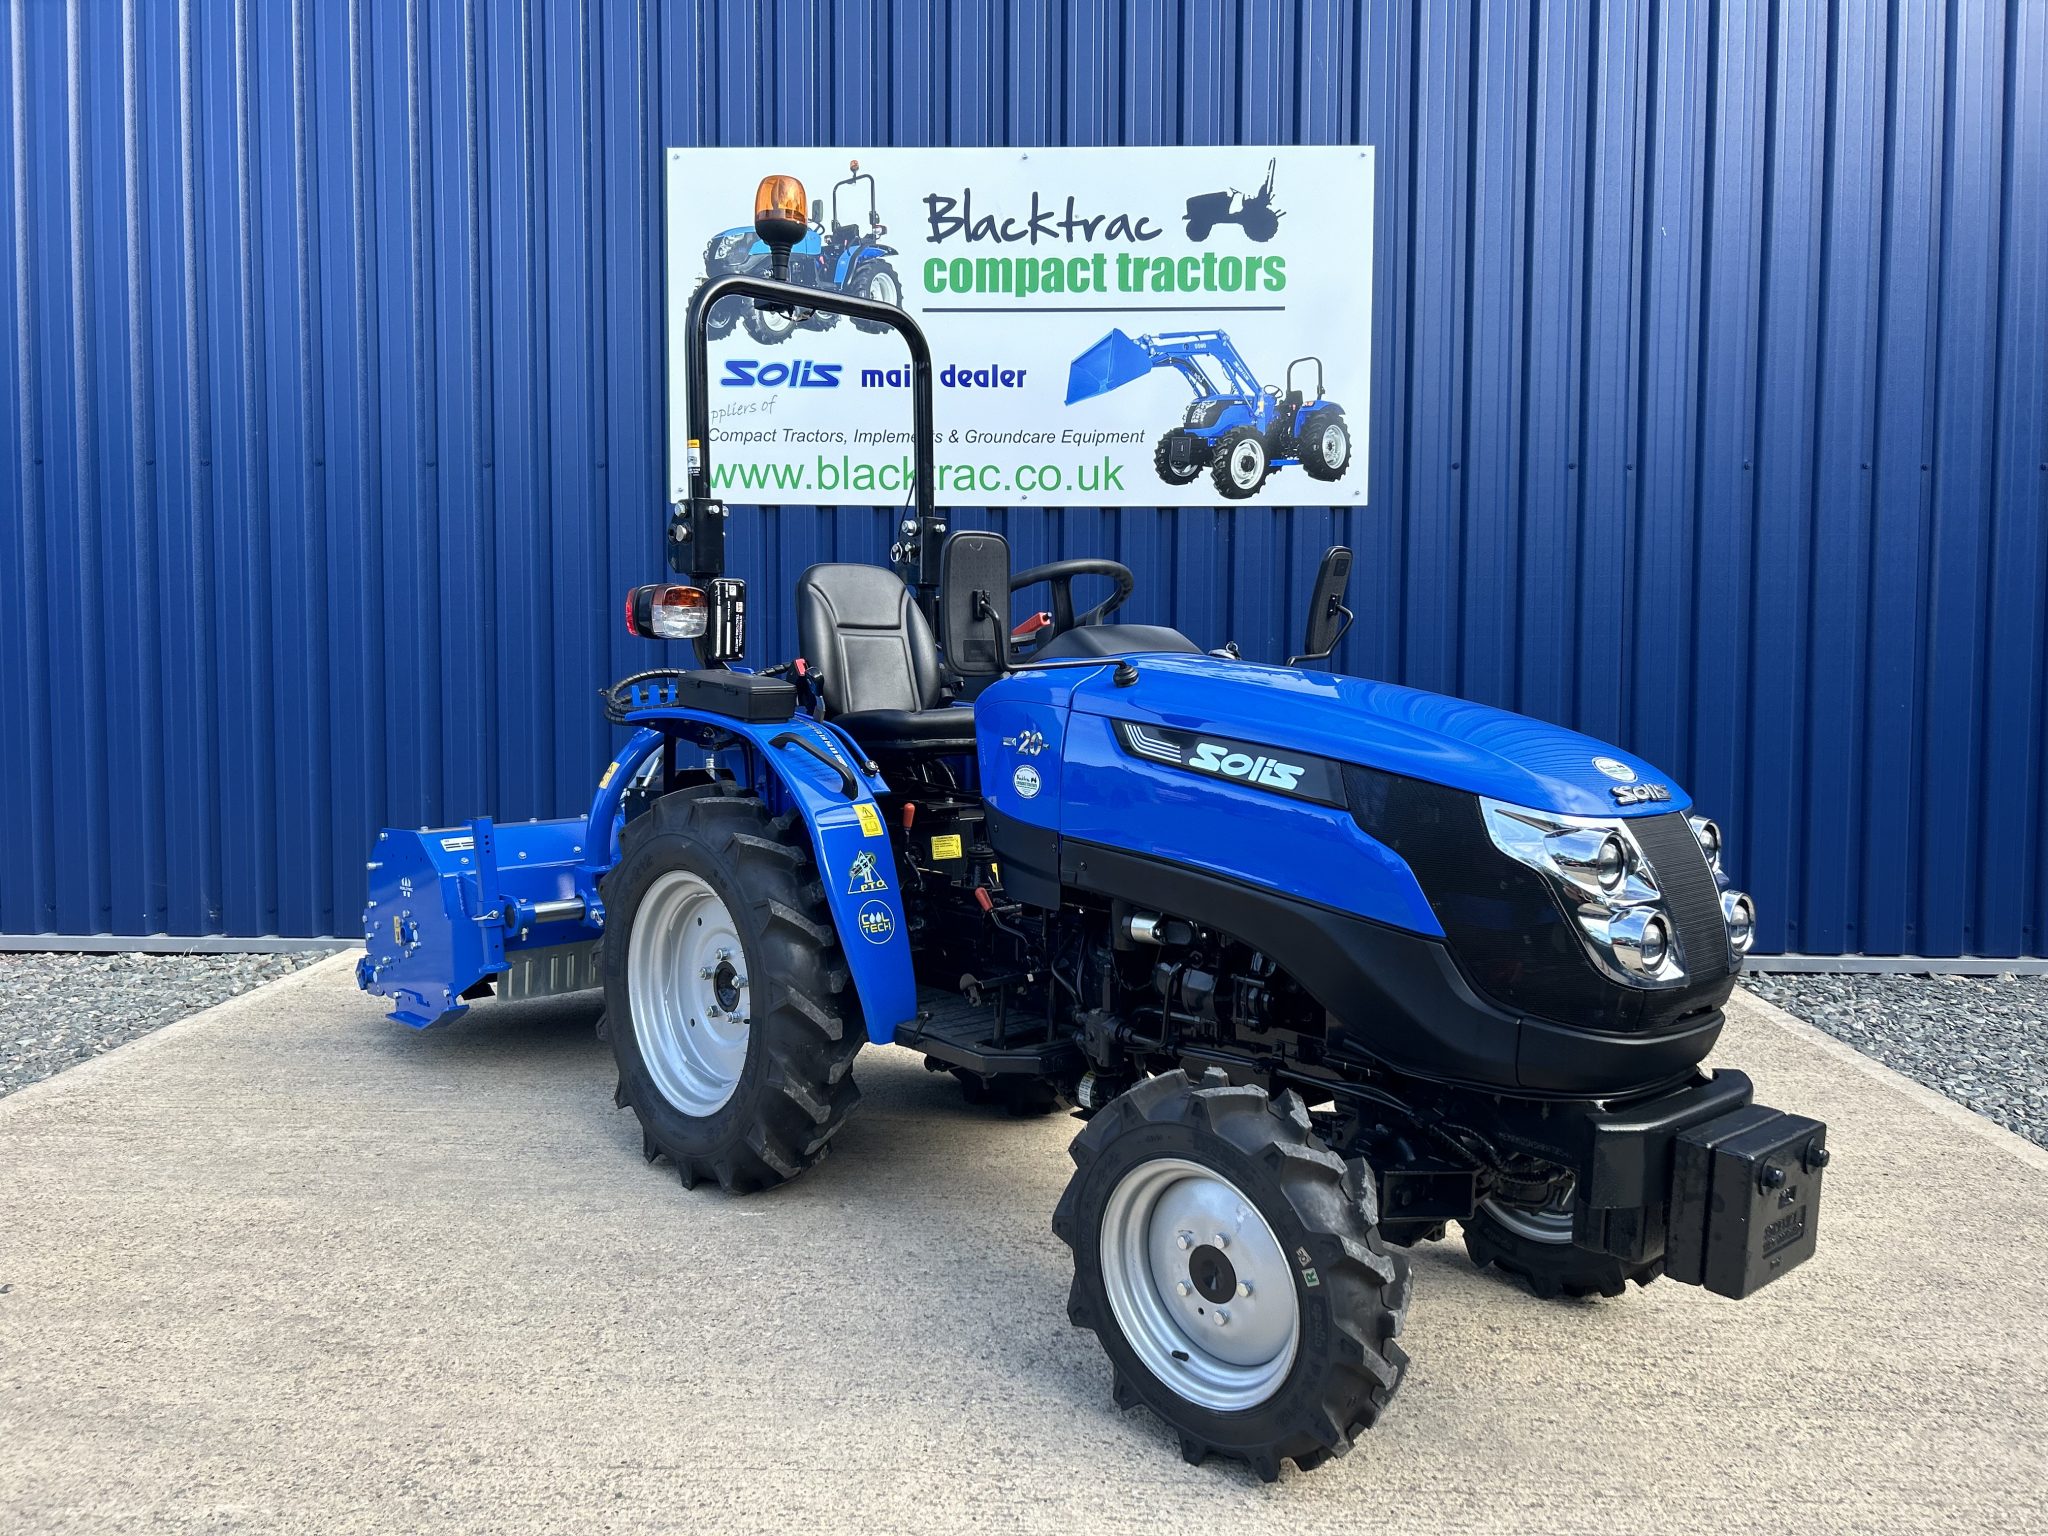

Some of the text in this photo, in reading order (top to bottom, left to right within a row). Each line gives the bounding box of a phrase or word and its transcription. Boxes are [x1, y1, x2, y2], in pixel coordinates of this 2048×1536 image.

[922, 188, 1163, 245] Blacktrac
[924, 252, 1287, 297] compact tractors
[862, 364, 1026, 387] mai dealer
[761, 395, 777, 414] of
[708, 428, 777, 446] Compact
[783, 428, 847, 445] Tractors,
[949, 429, 959, 443] &
[965, 430, 1056, 443] Groundcare
[1062, 430, 1145, 447] Equipment
[710, 455, 1125, 490] www.blackrac.co.uk
[1016, 730, 1043, 756] 20
[861, 880, 885, 892] PTO
[862, 922, 891, 934] TECH
